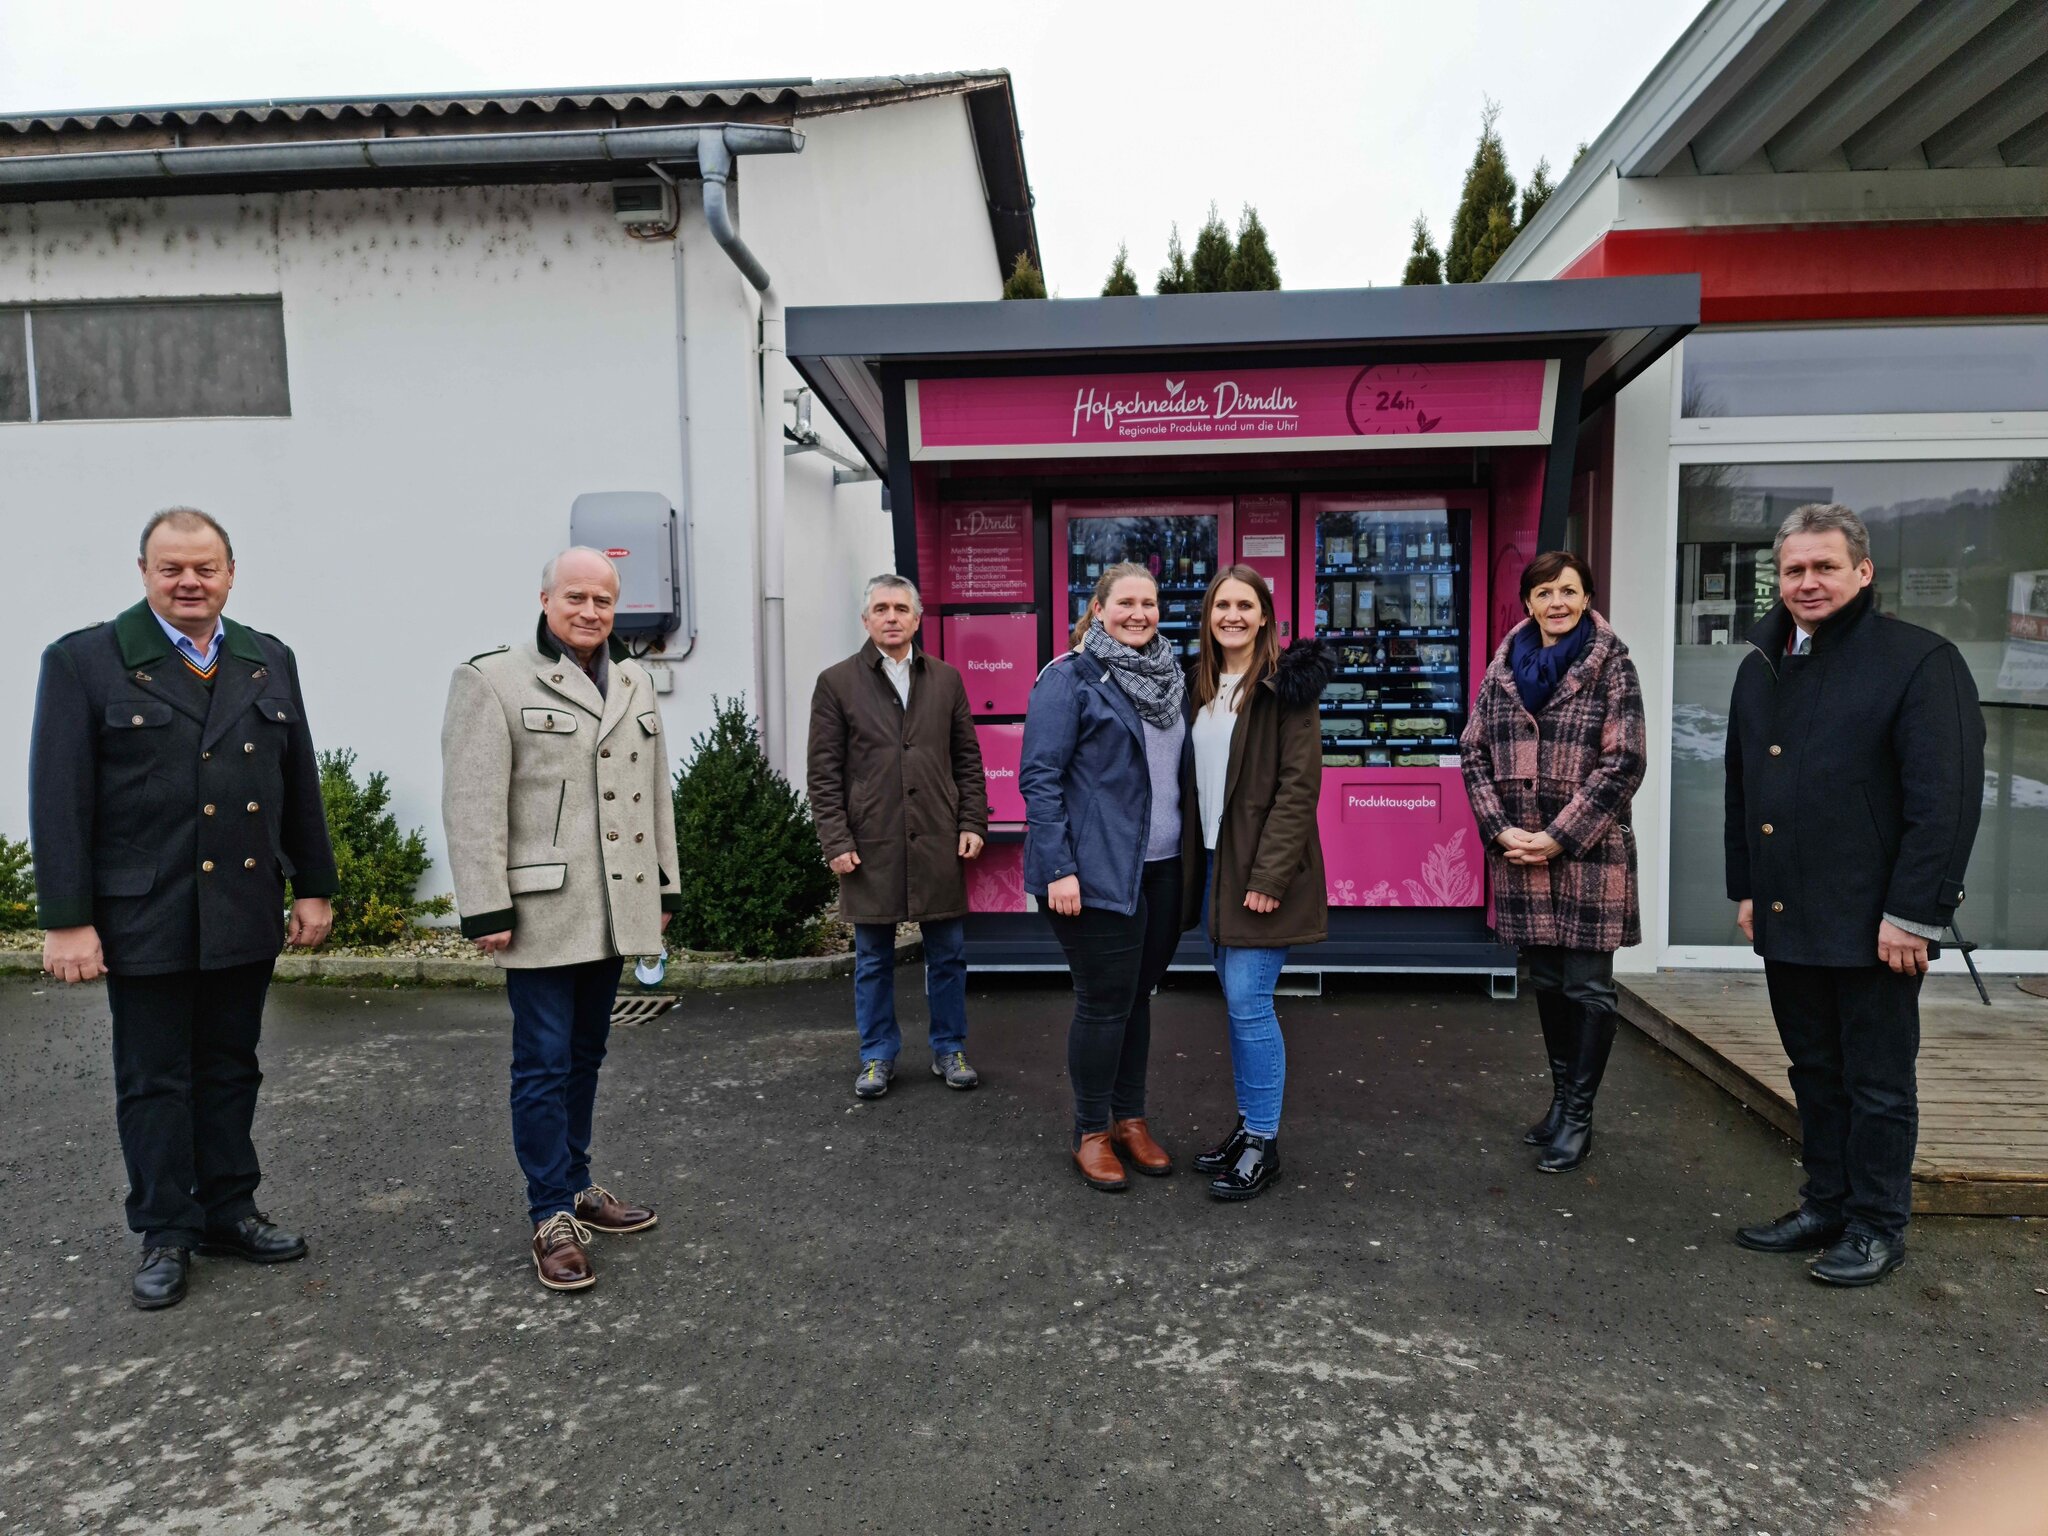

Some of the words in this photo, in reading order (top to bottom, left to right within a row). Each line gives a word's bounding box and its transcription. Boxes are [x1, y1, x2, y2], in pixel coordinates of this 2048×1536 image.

[1072, 388, 1208, 437] Hofschneider
[1213, 381, 1297, 419] Dirndln
[1376, 391, 1415, 410] 24h
[1119, 424, 1167, 437] Regionale
[1170, 423, 1212, 433] Produkte
[1215, 421, 1237, 431] rund
[1240, 422, 1255, 431] um
[1258, 421, 1273, 431] die
[1277, 420, 1298, 431] Uhr!
[968, 510, 1016, 536] Dirndl
[968, 660, 1013, 672] Rückgabe
[985, 767, 1014, 780] kgabe
[1349, 796, 1437, 810] Produktausgabe
